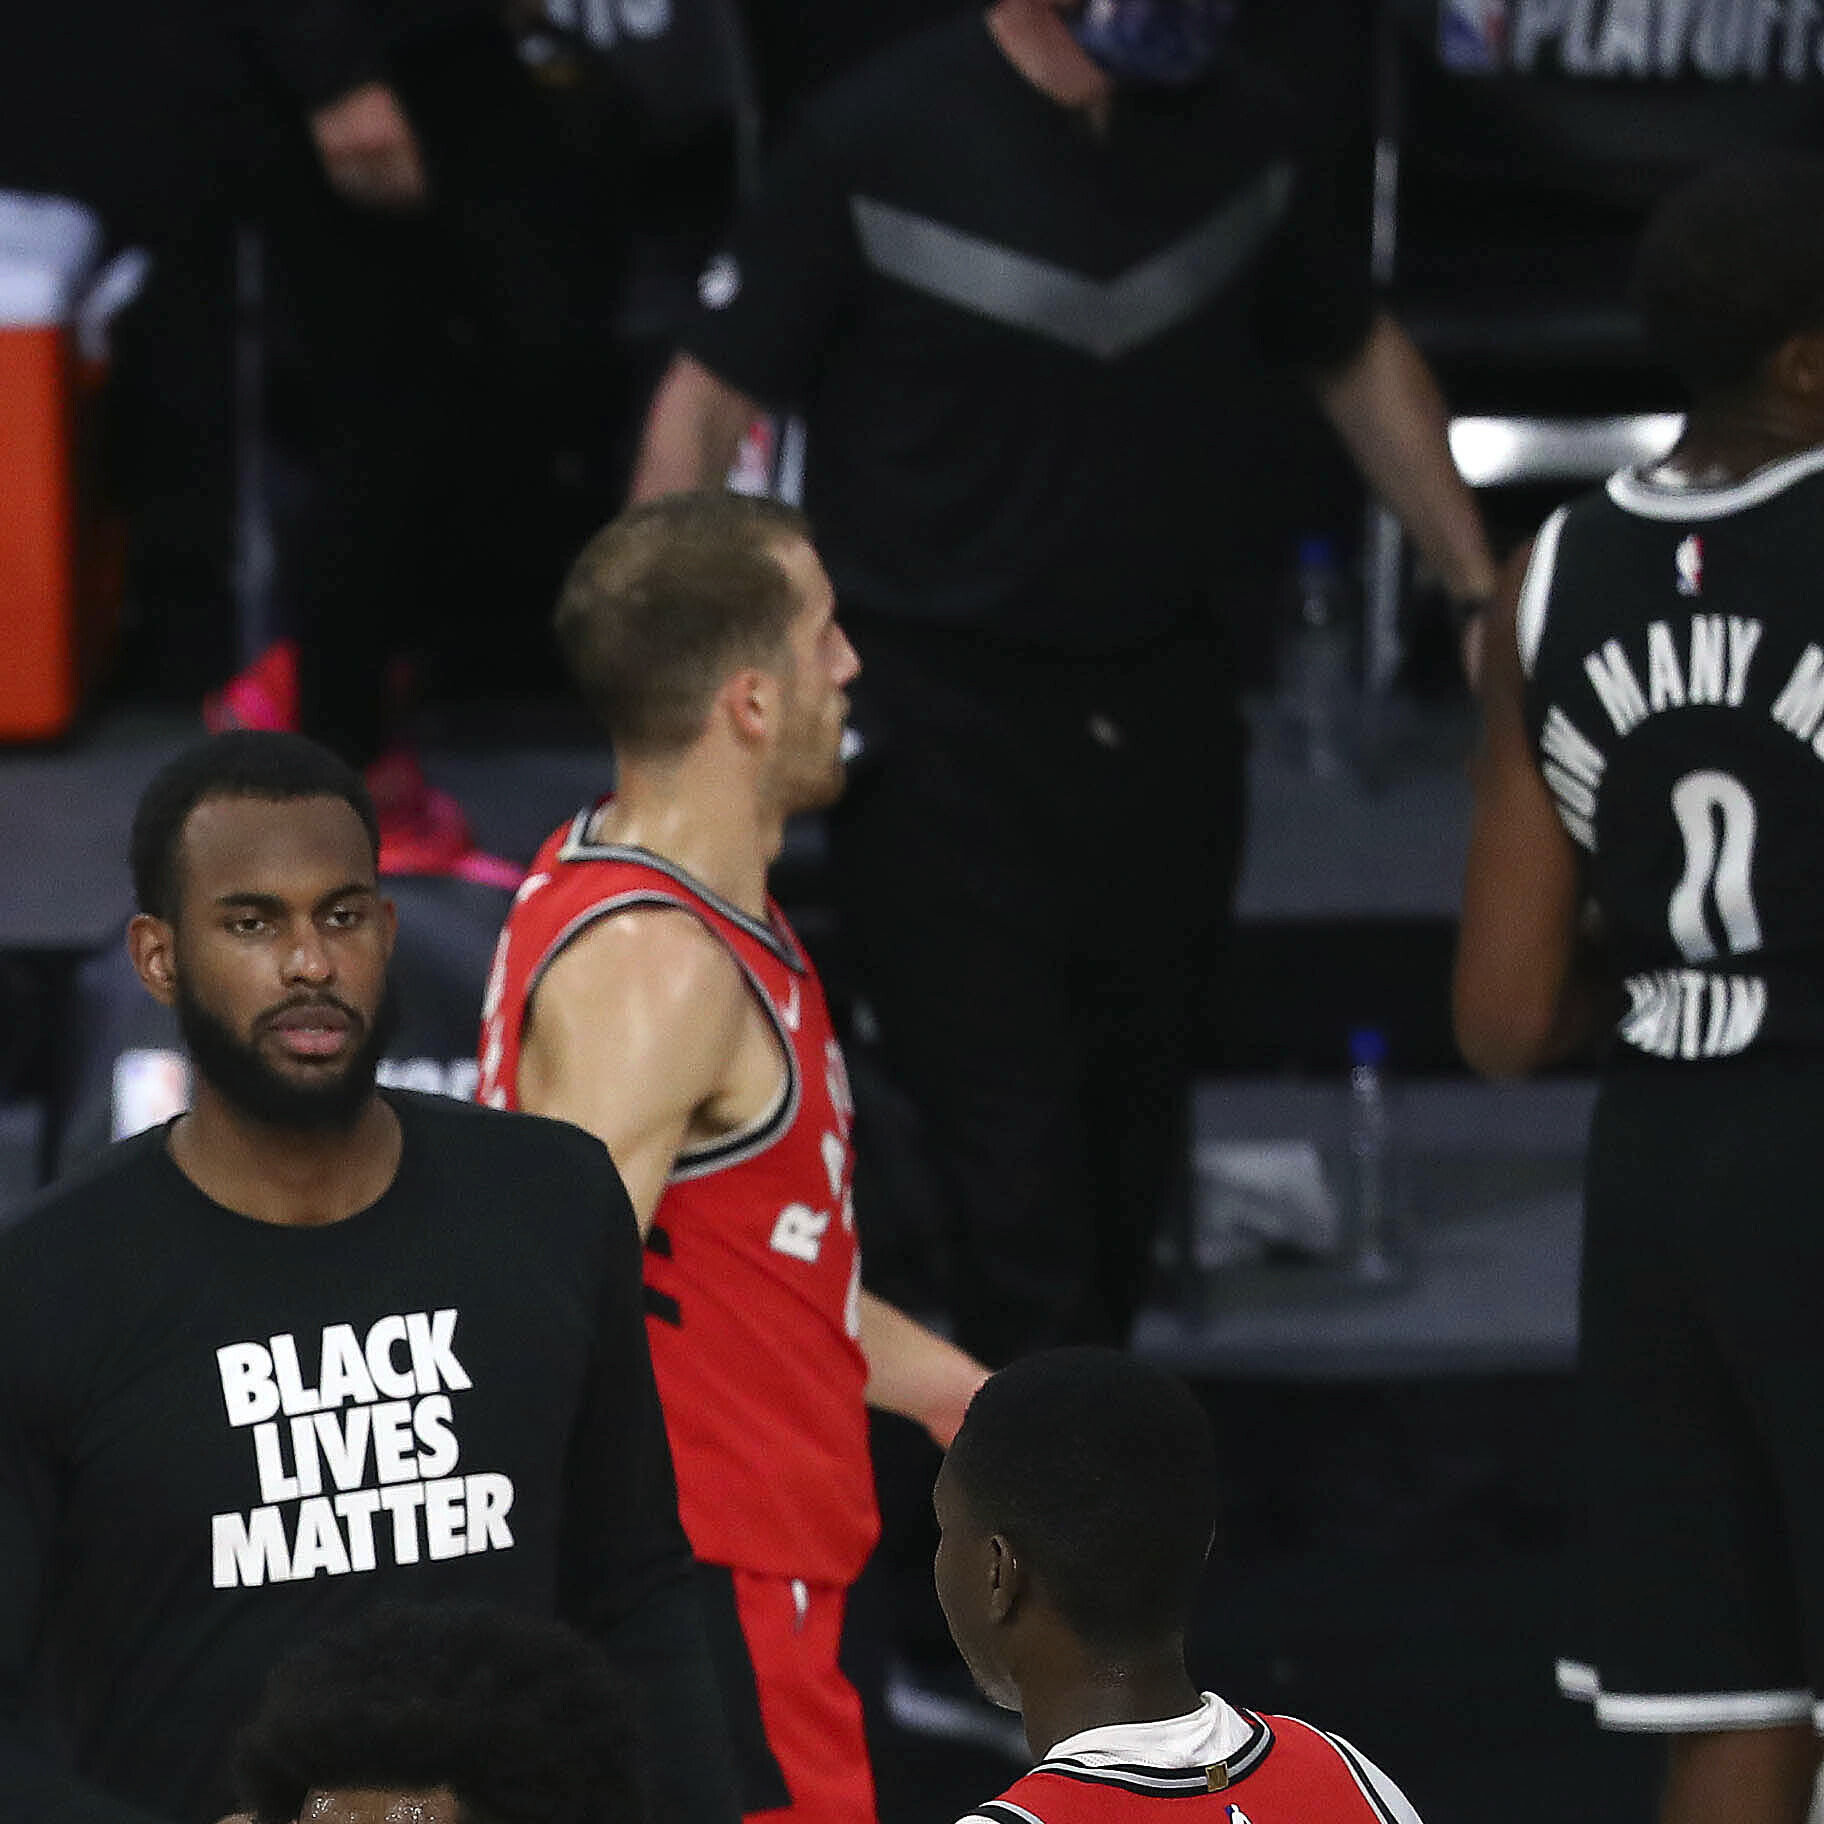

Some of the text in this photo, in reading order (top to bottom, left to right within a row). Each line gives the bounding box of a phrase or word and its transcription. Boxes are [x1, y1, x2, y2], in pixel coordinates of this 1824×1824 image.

[1583, 613, 1763, 738] MANY
[215, 1308, 474, 1428] BLACK
[253, 1393, 460, 1504] LIVES
[211, 1471, 515, 1588] MATTER
